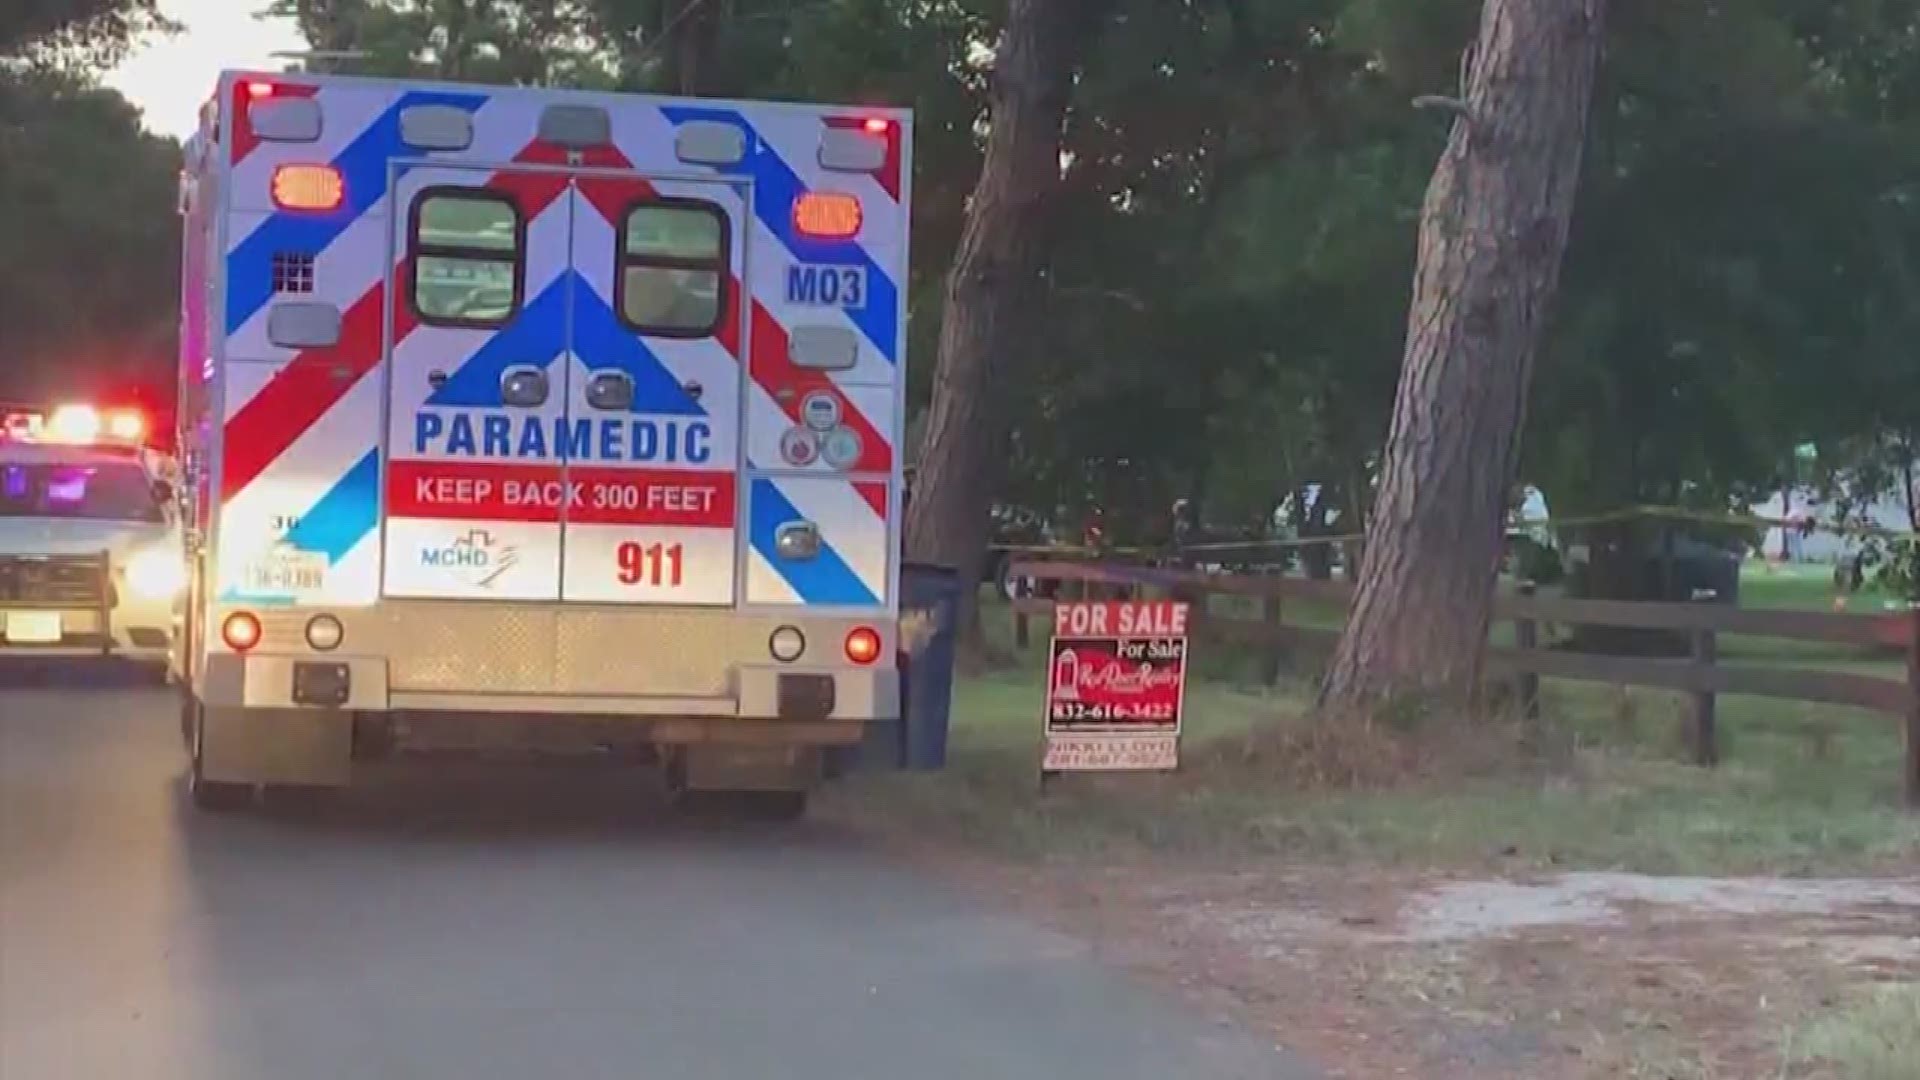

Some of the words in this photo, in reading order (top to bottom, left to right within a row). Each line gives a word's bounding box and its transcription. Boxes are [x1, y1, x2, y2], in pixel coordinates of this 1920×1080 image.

[788, 267, 861, 305] M03
[416, 412, 711, 463] PARAMEDIC
[416, 476, 491, 504] KEEP
[502, 480, 584, 508] BACK
[593, 484, 638, 510] 300
[647, 485, 716, 512] FEET
[420, 548, 488, 567] MCHD
[617, 540, 683, 587] 911
[1055, 604, 1108, 634] FOR
[1119, 604, 1188, 634] SALE
[1117, 639, 1145, 659] For
[1147, 640, 1182, 660] Sale
